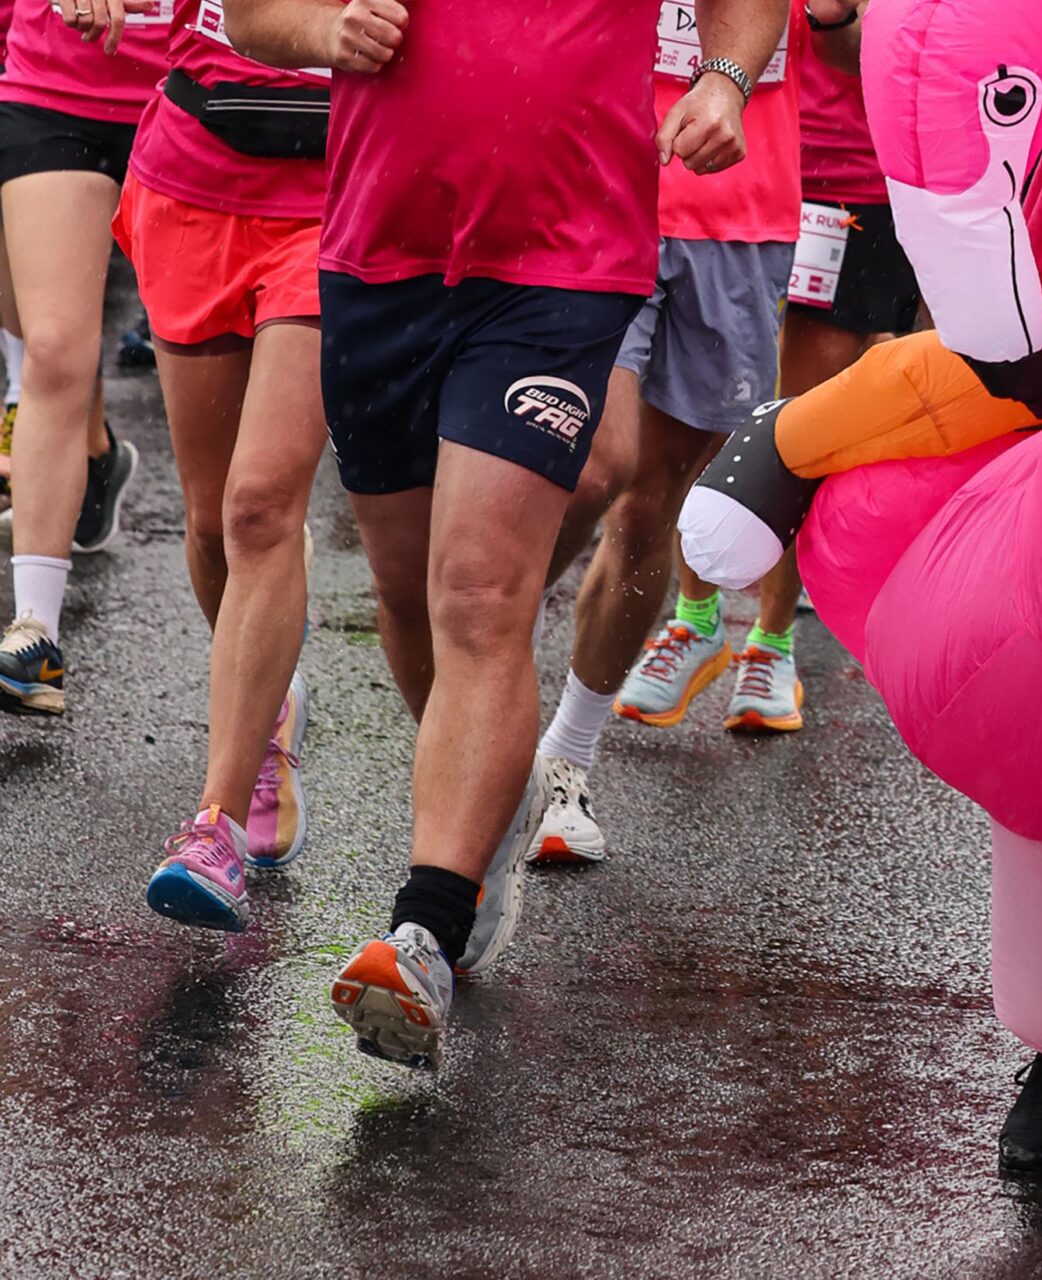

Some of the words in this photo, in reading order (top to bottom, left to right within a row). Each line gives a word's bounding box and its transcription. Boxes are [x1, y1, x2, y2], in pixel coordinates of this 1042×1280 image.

[514, 395, 584, 437] TAG
[525, 388, 559, 405] BUD
[558, 401, 588, 421] LIGHT
